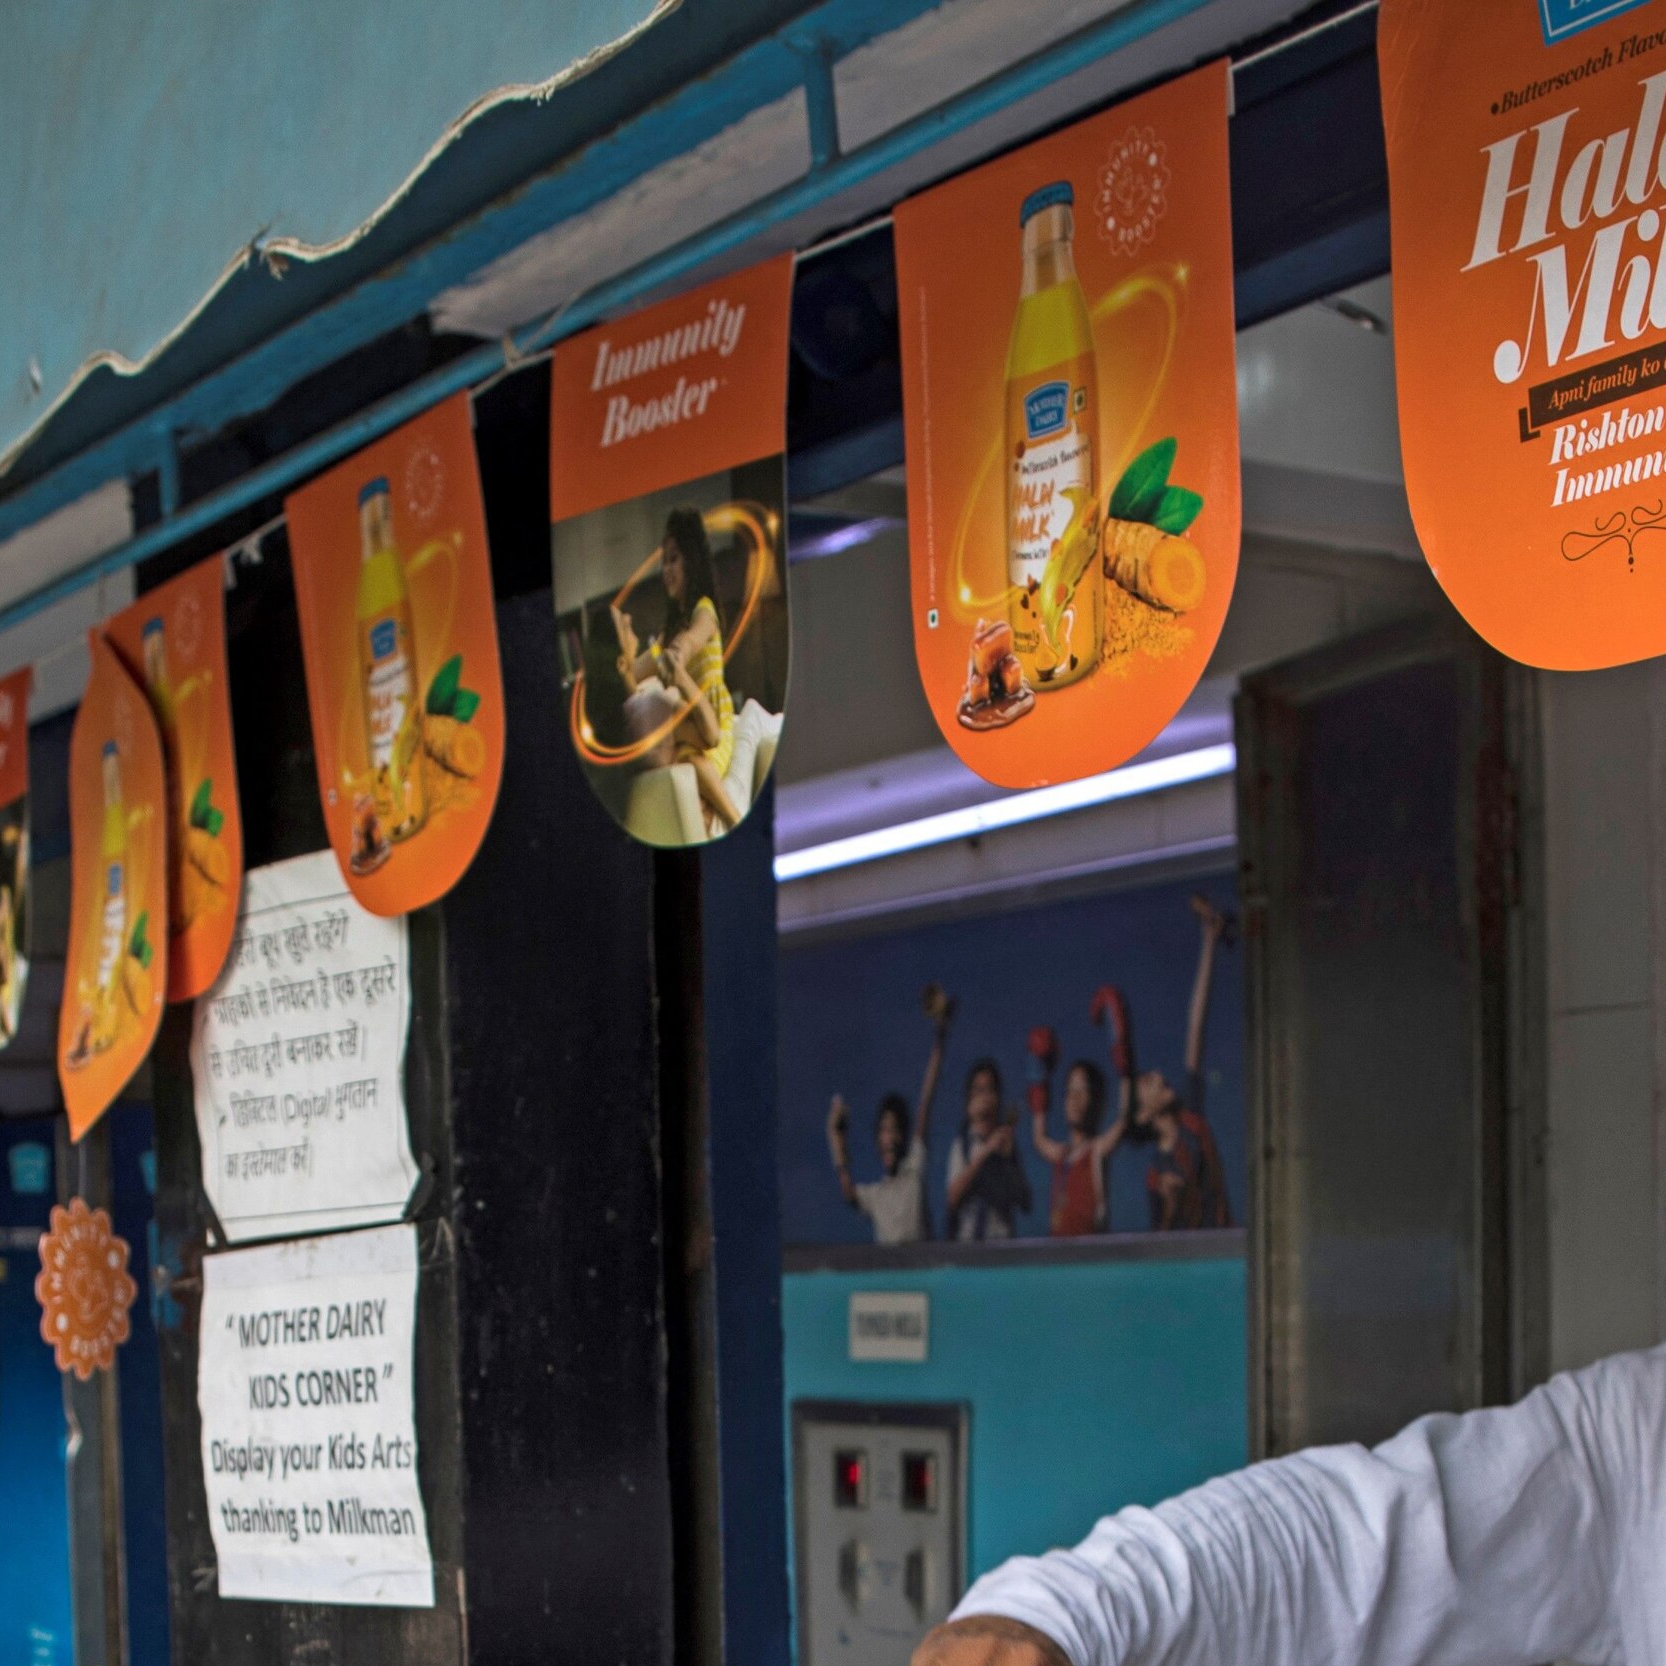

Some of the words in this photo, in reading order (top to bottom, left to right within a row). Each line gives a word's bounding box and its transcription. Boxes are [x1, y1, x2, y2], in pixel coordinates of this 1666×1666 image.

[1500, 47, 1614, 115] Butterscotch
[591, 298, 745, 391] Immunity
[600, 372, 718, 448] Booster
[1547, 384, 1585, 410] Apni
[1584, 364, 1637, 405] family
[1640, 356, 1661, 379] ko
[1548, 402, 1666, 465] Rishton
[326, 1298, 387, 1339] DAIRY
[249, 1373, 291, 1410] KIDS
[211, 1438, 274, 1481] Display
[279, 1441, 322, 1481] your
[328, 1432, 365, 1470] Kids
[372, 1430, 412, 1469] Arts
[220, 1499, 298, 1543] thanking
[303, 1503, 321, 1535] to
[328, 1499, 416, 1536] Milkman
